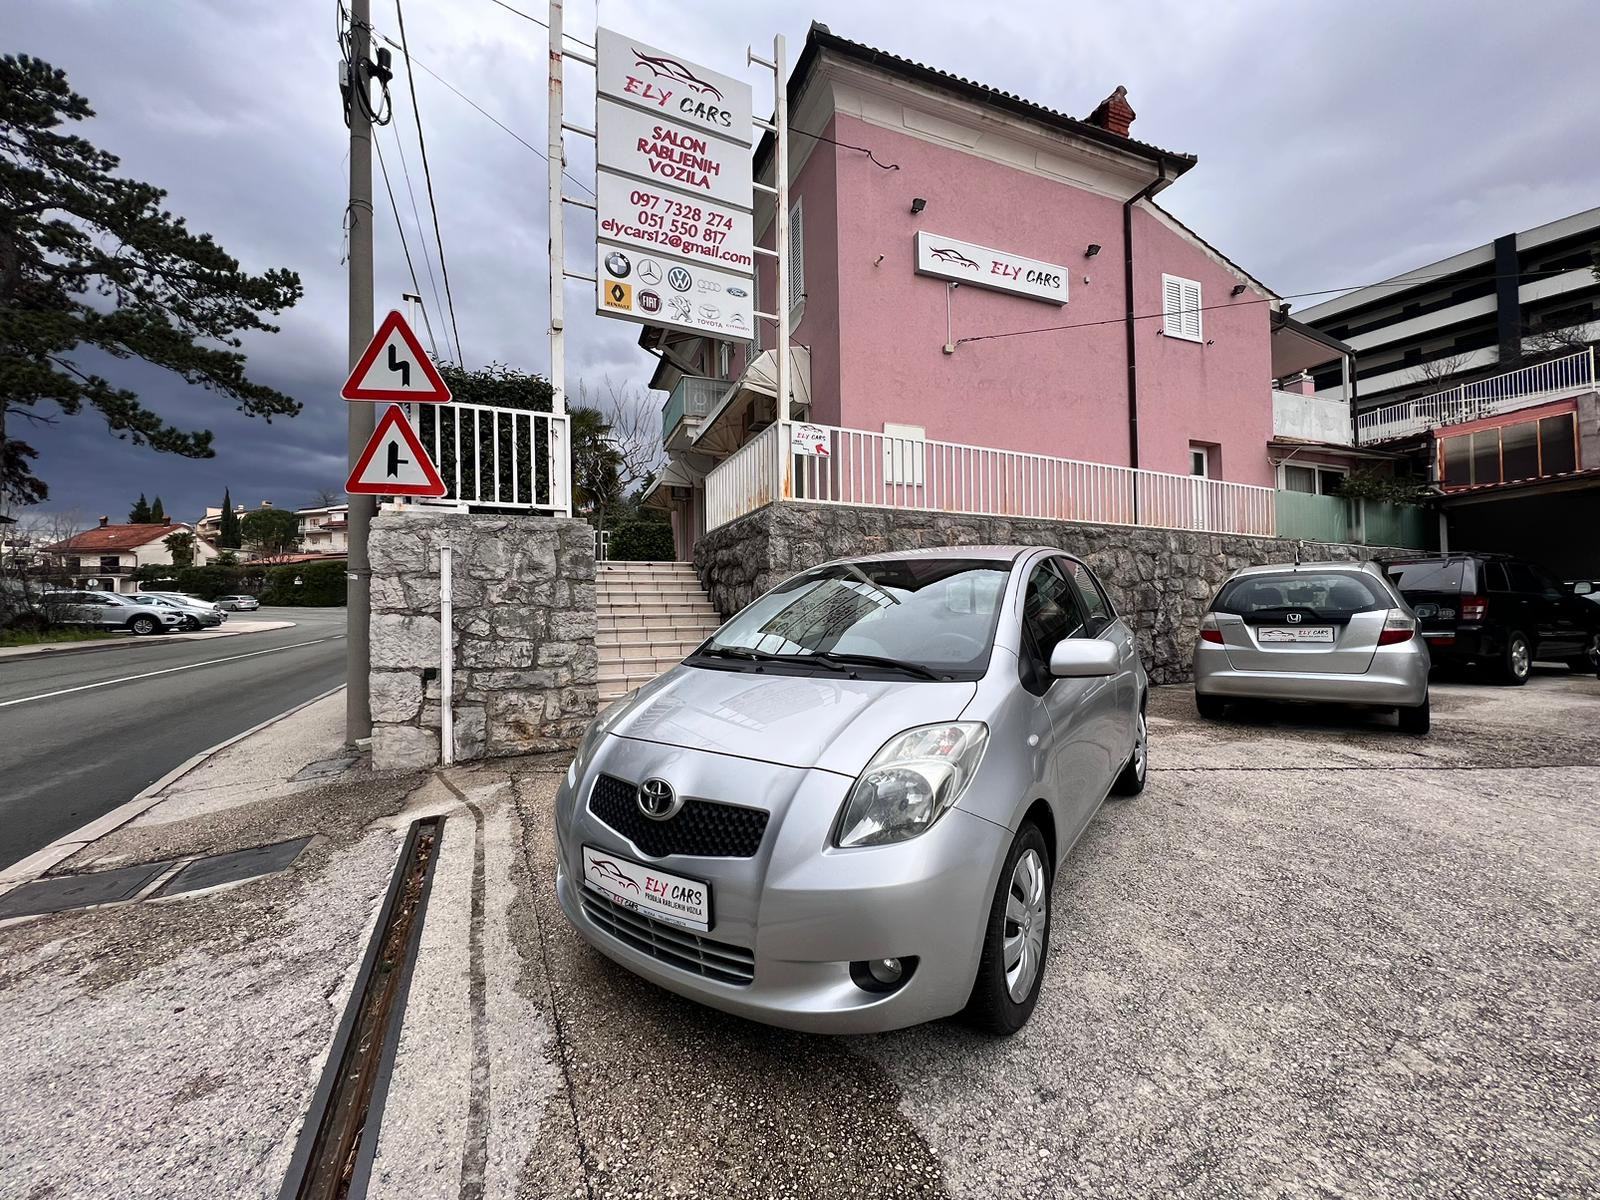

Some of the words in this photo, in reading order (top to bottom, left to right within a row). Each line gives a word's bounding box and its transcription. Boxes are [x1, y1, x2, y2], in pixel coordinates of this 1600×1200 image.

[623, 75, 673, 107] ELY
[679, 97, 732, 128] CARS
[651, 125, 707, 156] SALON
[637, 137, 721, 177] RABLJENIH
[648, 158, 711, 190] VOZILA
[630, 190, 660, 210] 097
[664, 199, 702, 222] 7328
[705, 211, 733, 231] 274
[601, 217, 752, 267] elycars12@gmail.com
[637, 210, 664, 230] 051
[669, 220, 698, 239] 550
[702, 228, 727, 245] 817
[990, 260, 1022, 281] ELY
[1026, 269, 1061, 289] CARS
[642, 295, 658, 309] FIAT
[697, 318, 723, 329] TOYOTA
[624, 900, 639, 912] CARS
[645, 876, 669, 897] ELY
[671, 885, 702, 906] CARS
